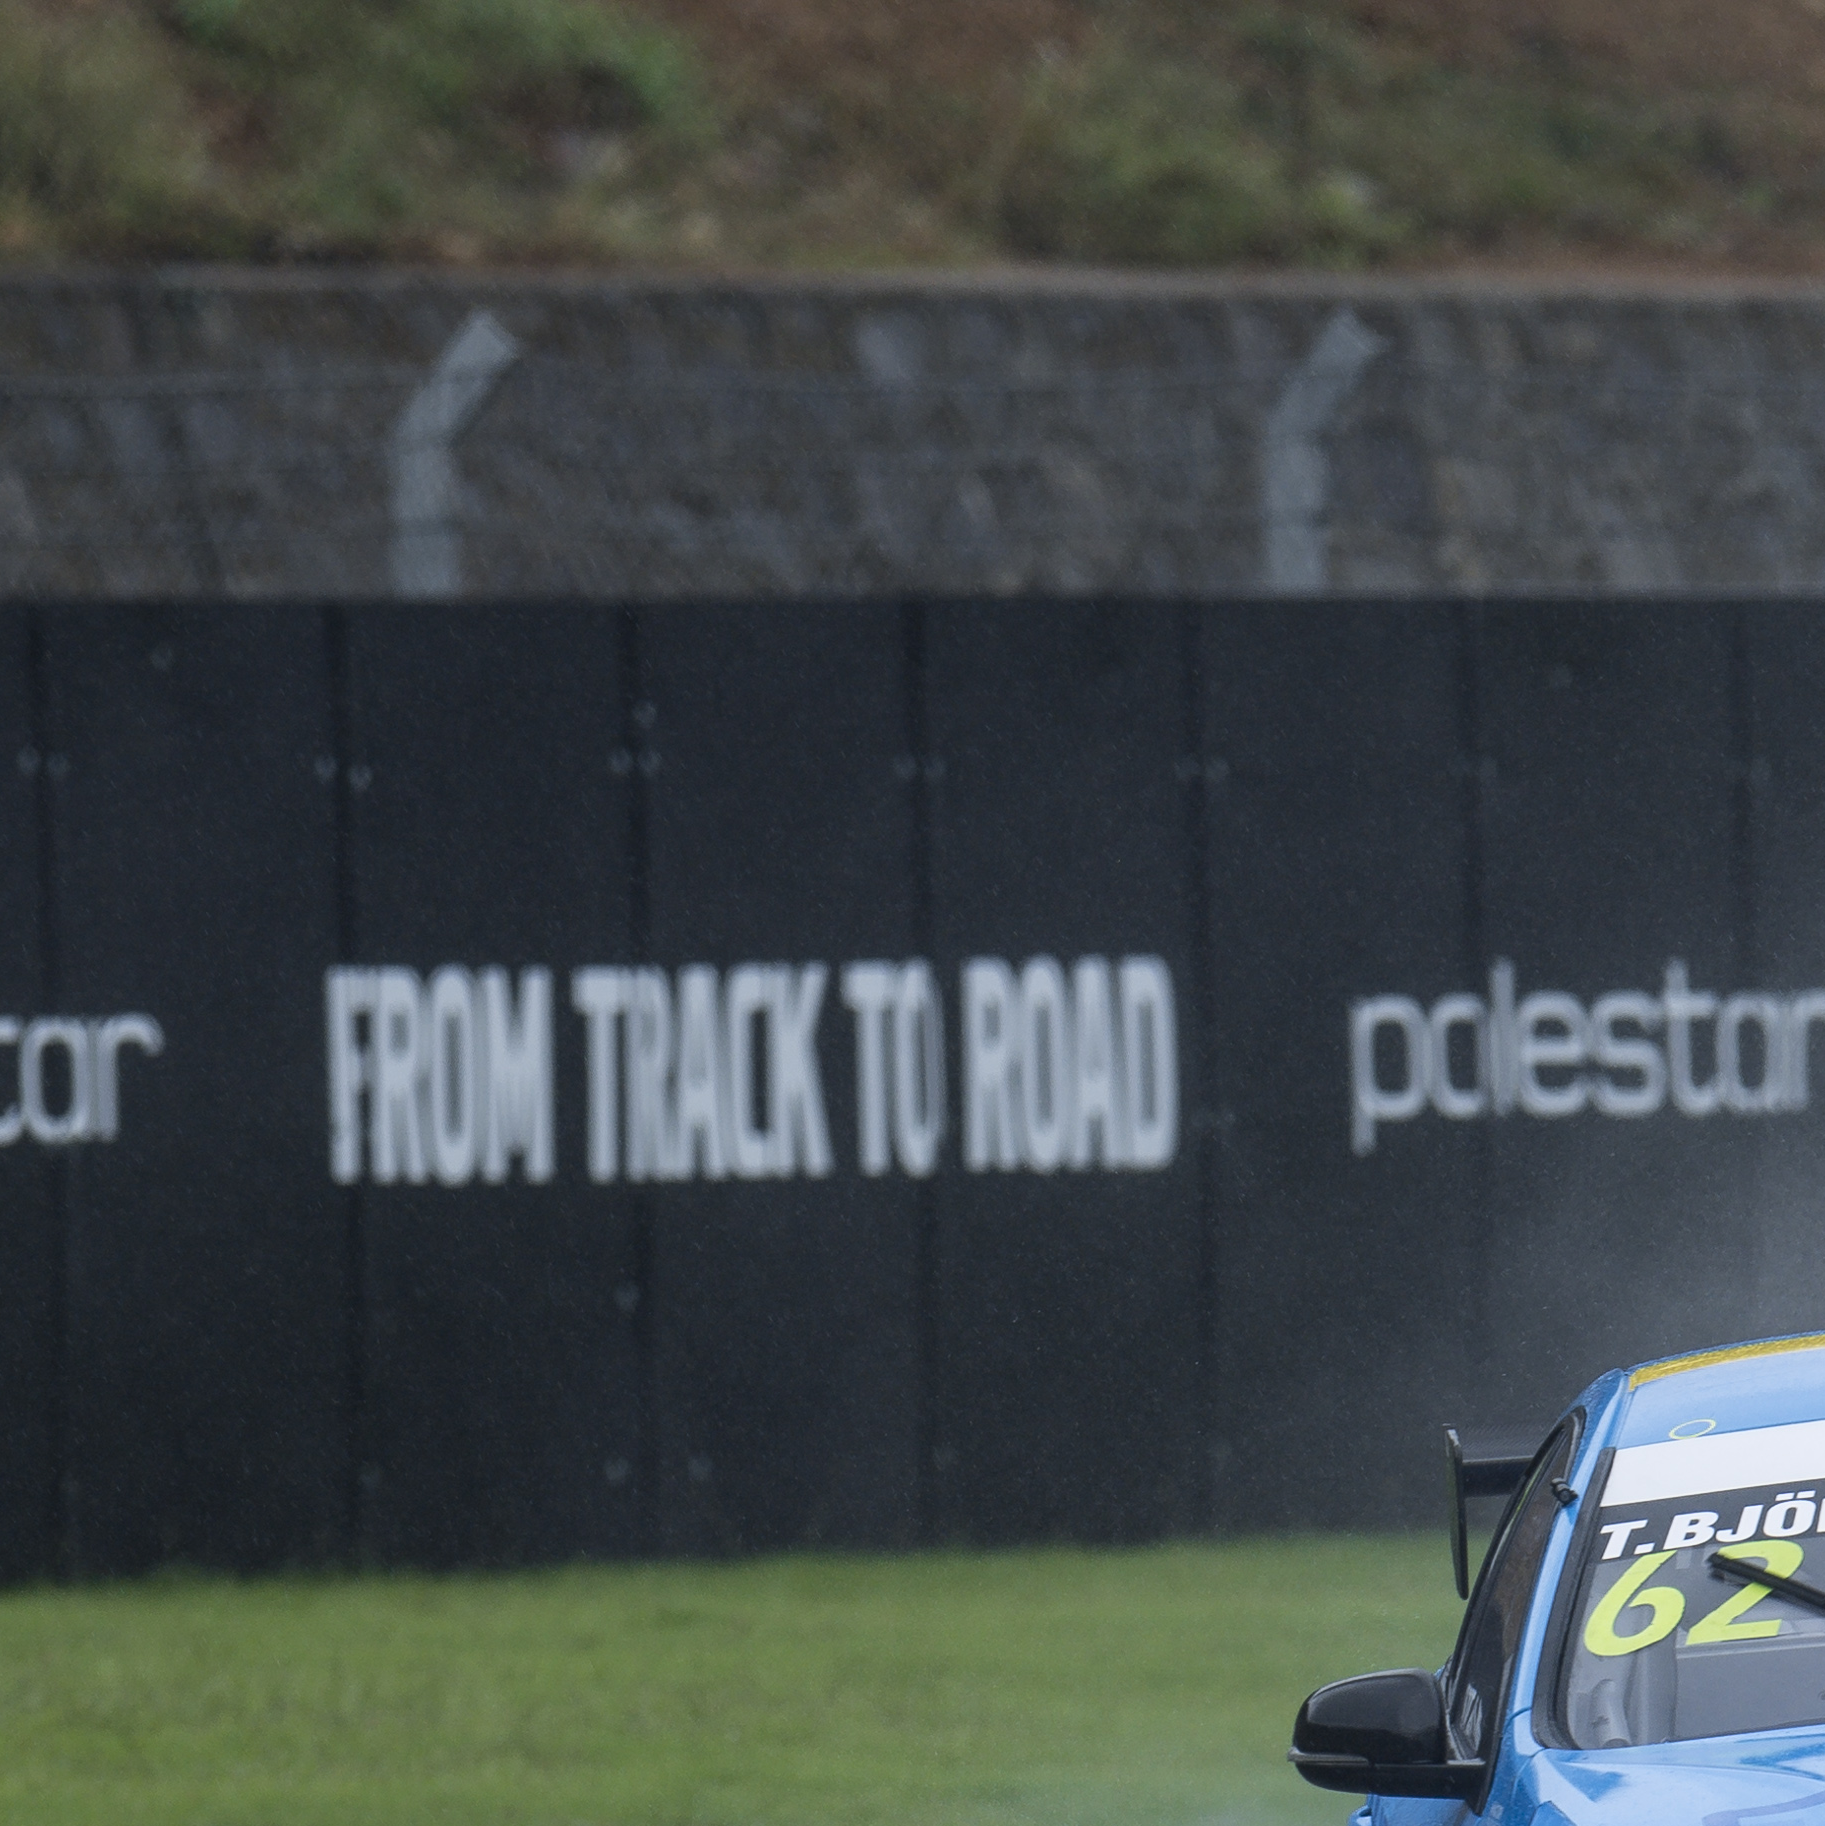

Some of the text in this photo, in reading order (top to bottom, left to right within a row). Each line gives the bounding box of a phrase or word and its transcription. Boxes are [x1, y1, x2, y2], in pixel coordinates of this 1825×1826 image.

[326, 955, 1178, 1186] FROM TRACK TO ROAD
[1582, 1539, 1805, 1657] 62
